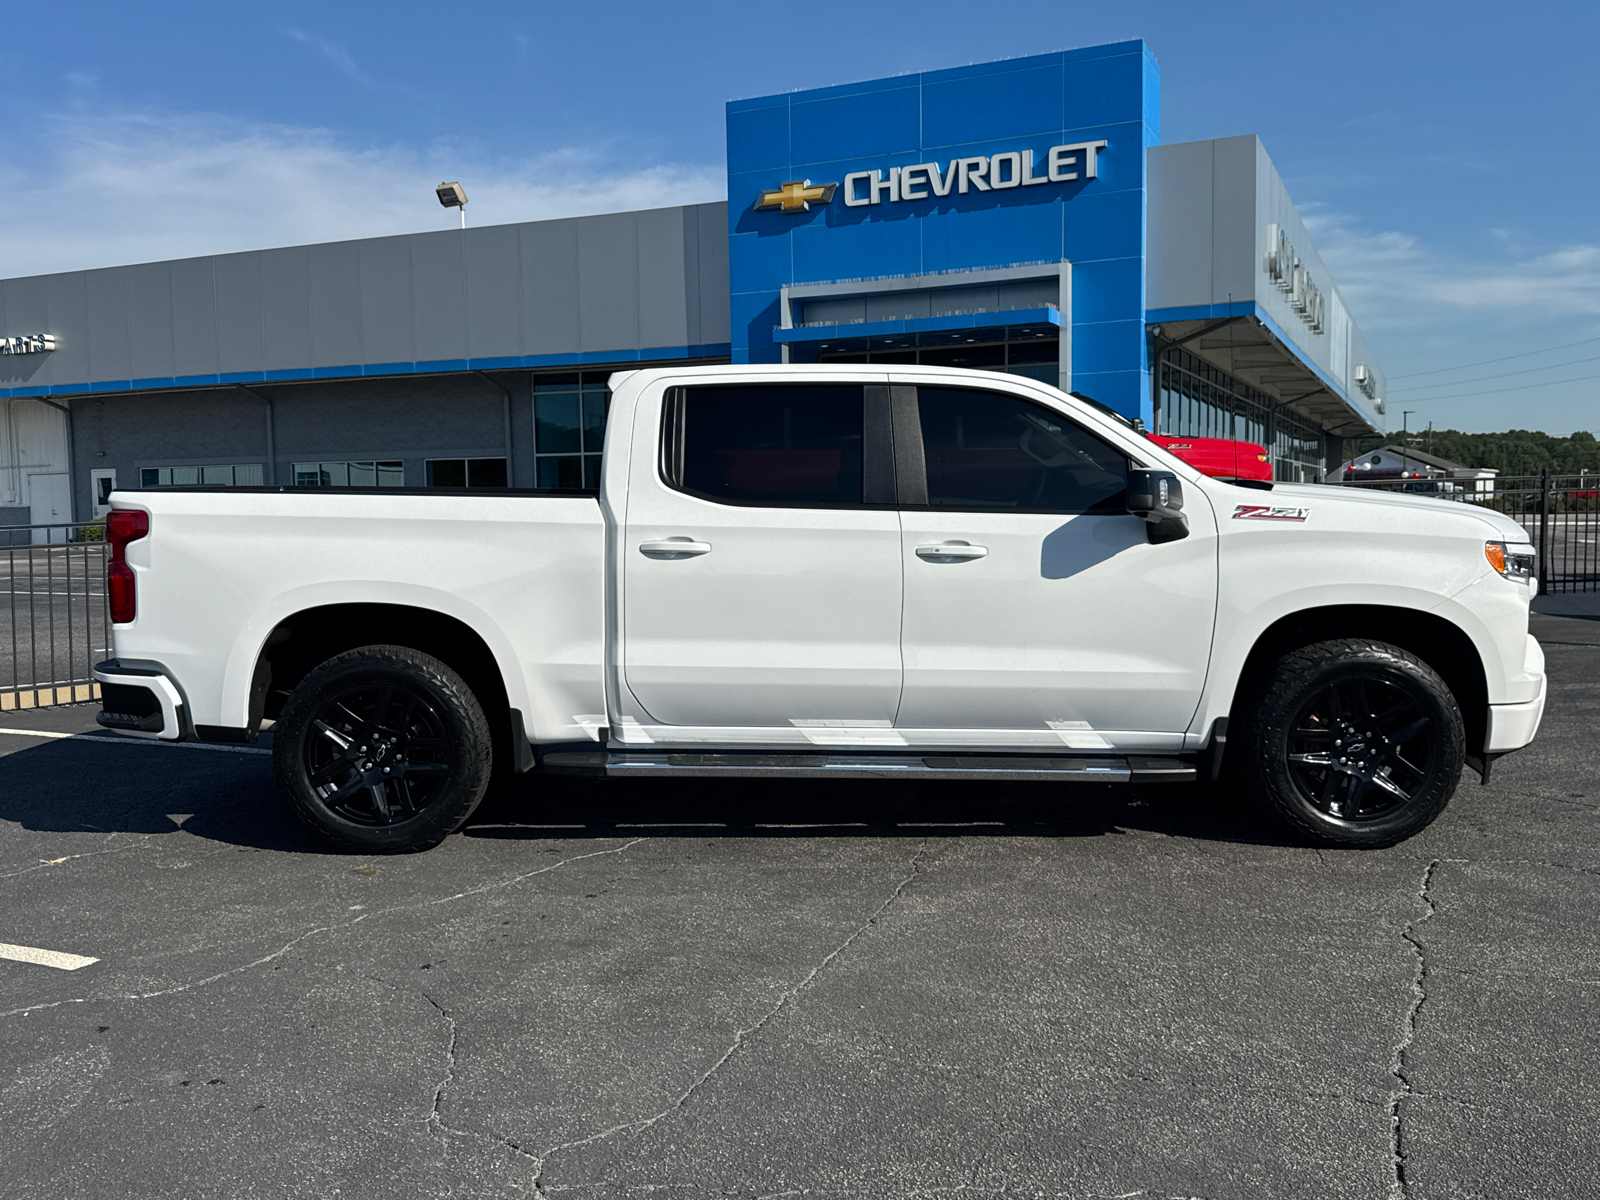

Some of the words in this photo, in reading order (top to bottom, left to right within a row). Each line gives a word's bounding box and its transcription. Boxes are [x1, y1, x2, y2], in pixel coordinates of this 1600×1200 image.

[843, 139, 1108, 207] CHEVROLET
[0, 333, 56, 355] ARTS
[1231, 503, 1312, 523] Z71
